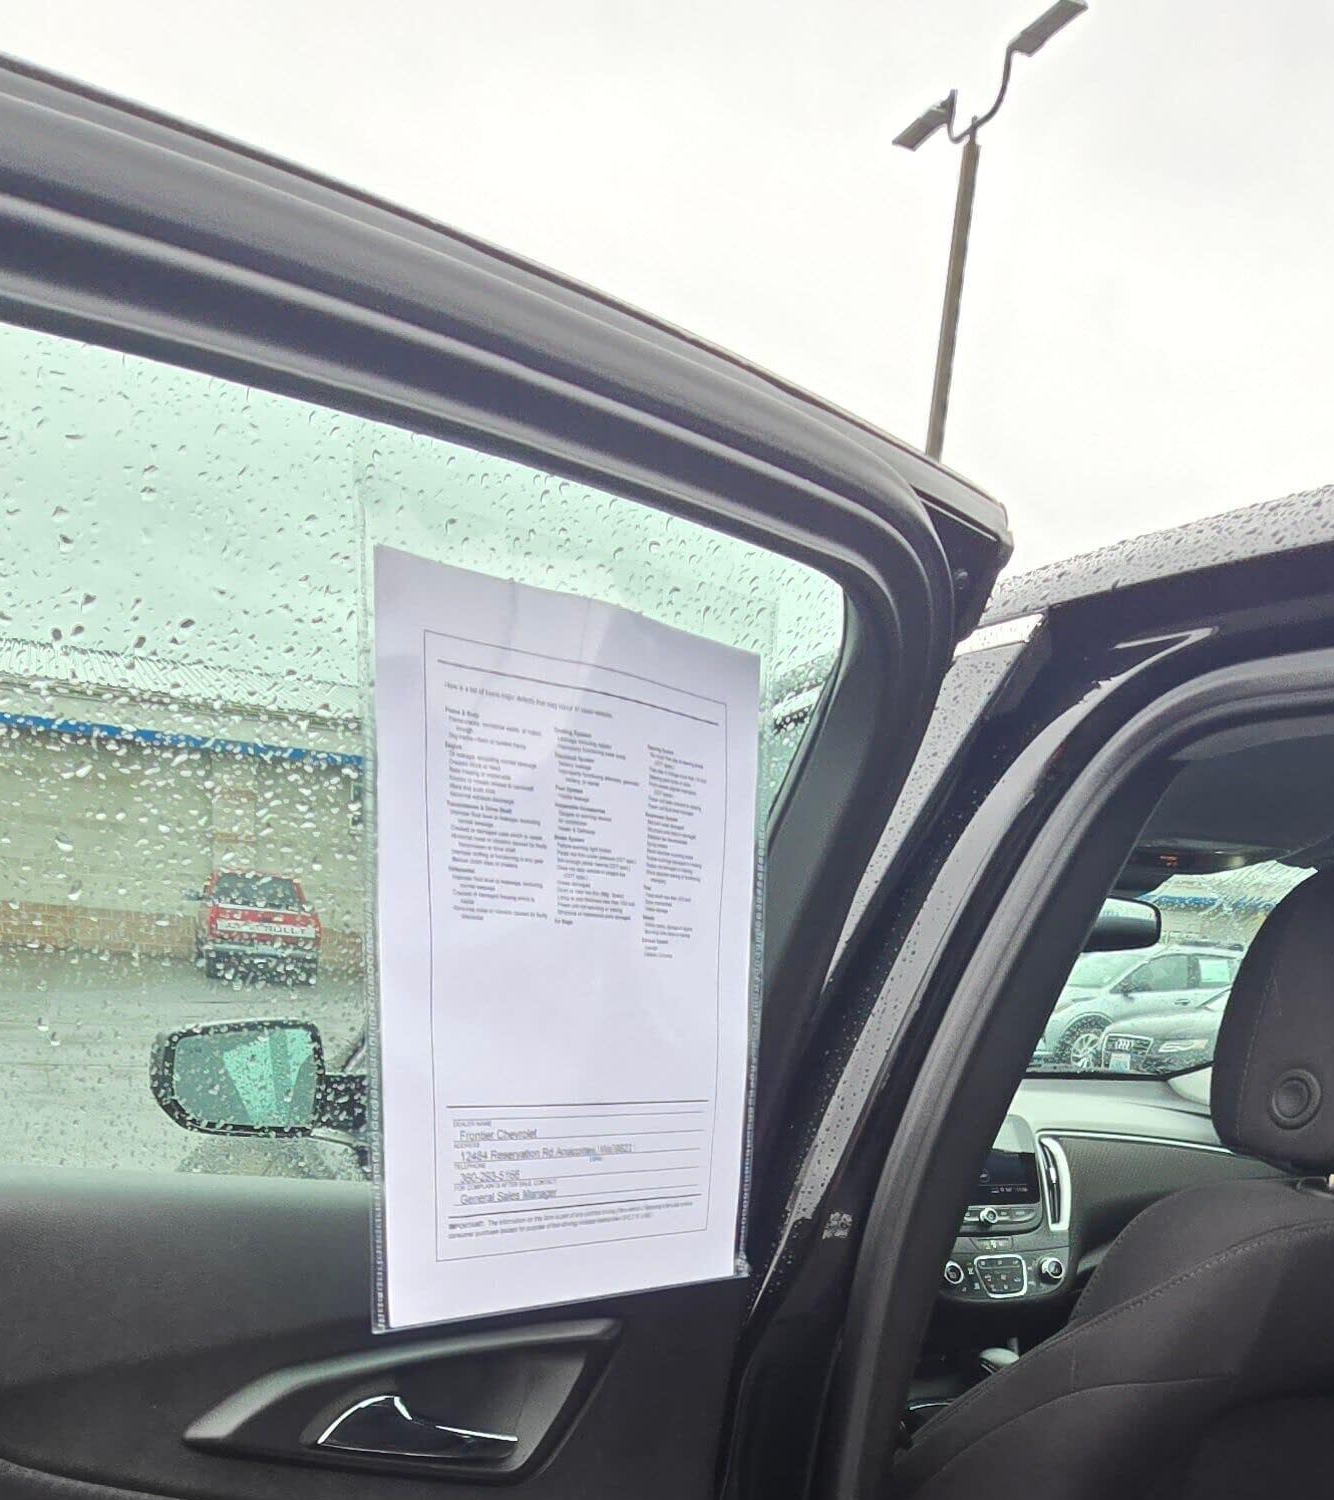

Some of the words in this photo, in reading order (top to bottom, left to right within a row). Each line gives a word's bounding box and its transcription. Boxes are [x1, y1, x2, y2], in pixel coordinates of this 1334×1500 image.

[459, 1130, 494, 1141] Frontier
[460, 1192, 495, 1205] General
[496, 1191, 520, 1202] Sales
